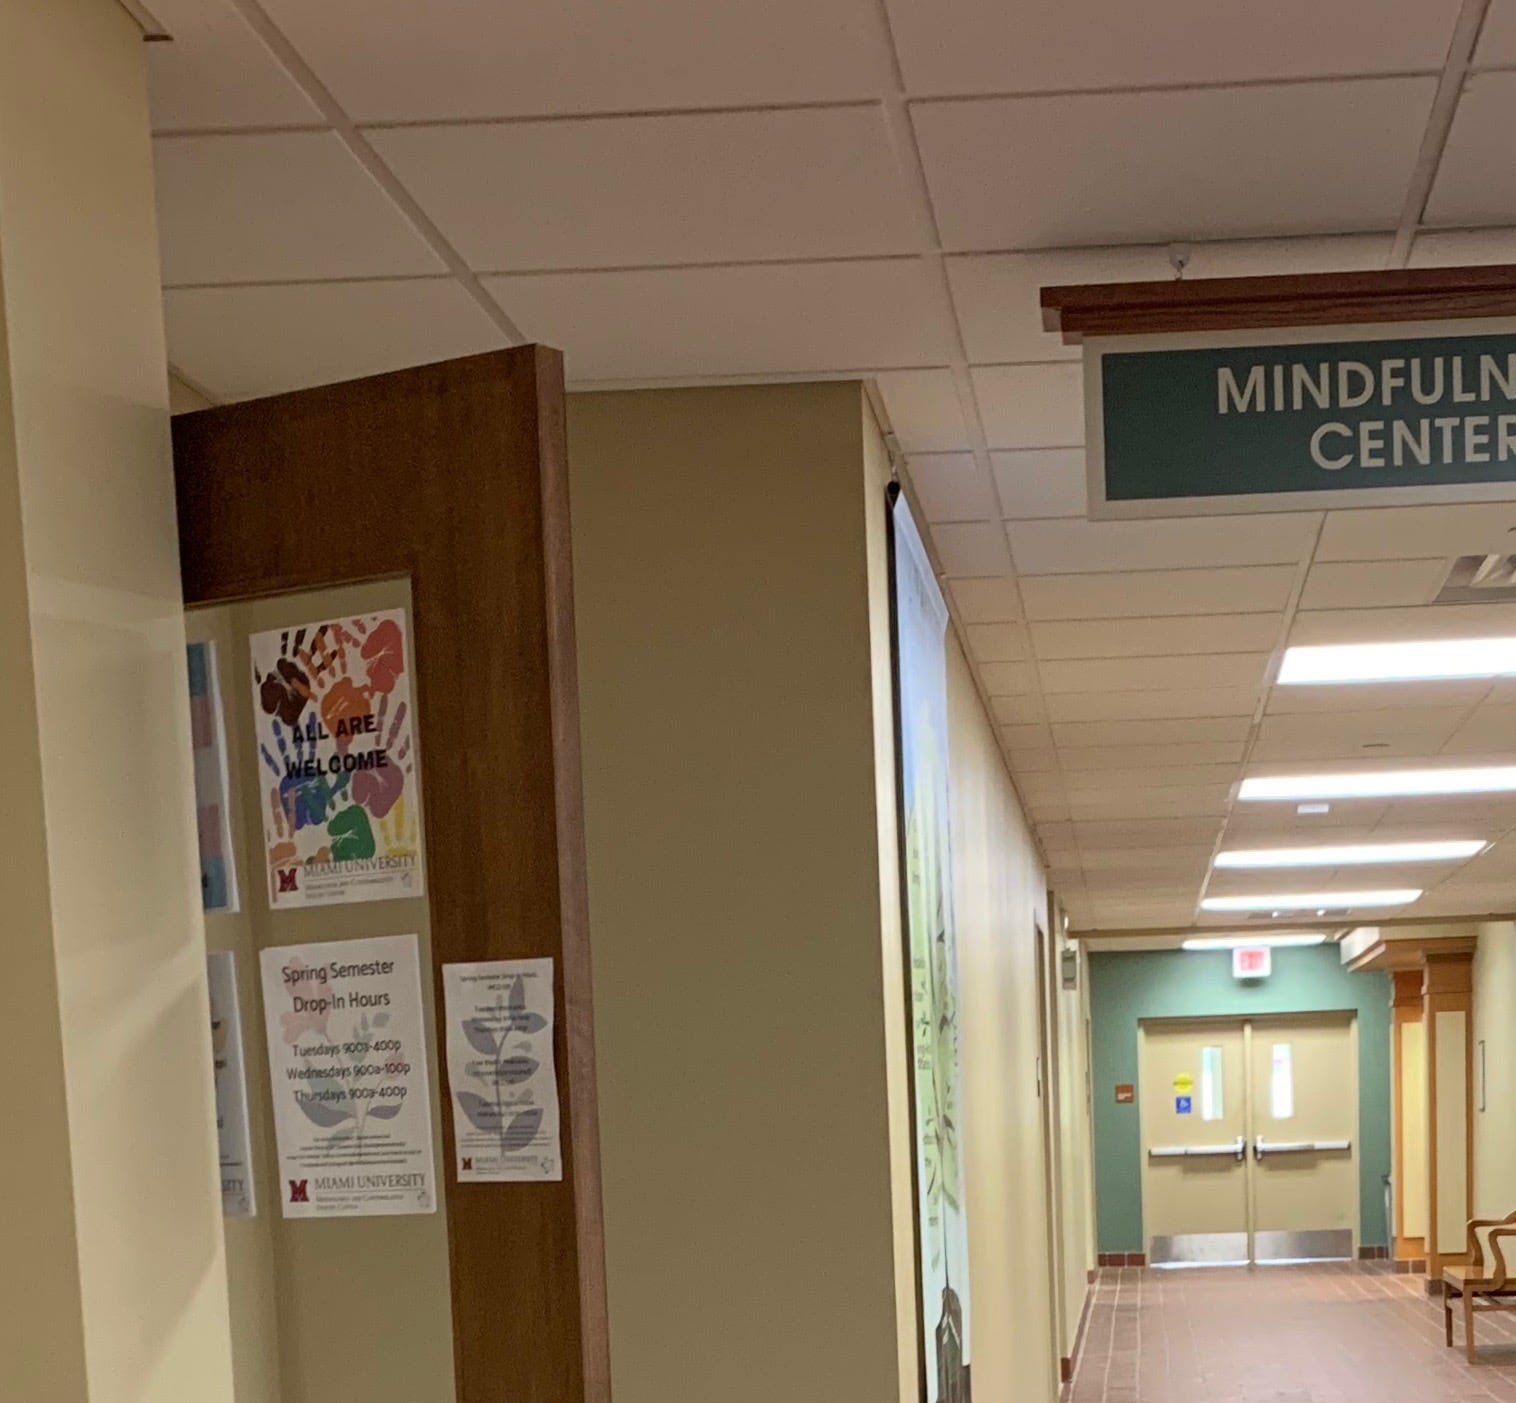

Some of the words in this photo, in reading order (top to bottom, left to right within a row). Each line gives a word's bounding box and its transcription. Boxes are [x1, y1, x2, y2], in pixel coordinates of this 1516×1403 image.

[292, 722, 329, 744] ALL
[335, 714, 377, 736] ARE
[285, 749, 388, 780] WELCOME
[345, 855, 416, 874] UNIVERSITY
[281, 964, 328, 985] Spring
[330, 960, 395, 979] Semester
[293, 994, 345, 1014] Drop-In
[349, 991, 391, 1008] Hours
[292, 1043, 341, 1059] Tuesdays
[286, 1065, 352, 1081] Wednesdays
[293, 1088, 346, 1104] Thursdays
[314, 1176, 354, 1191] MIAMI
[356, 1173, 426, 1189] UNIVERSITY
